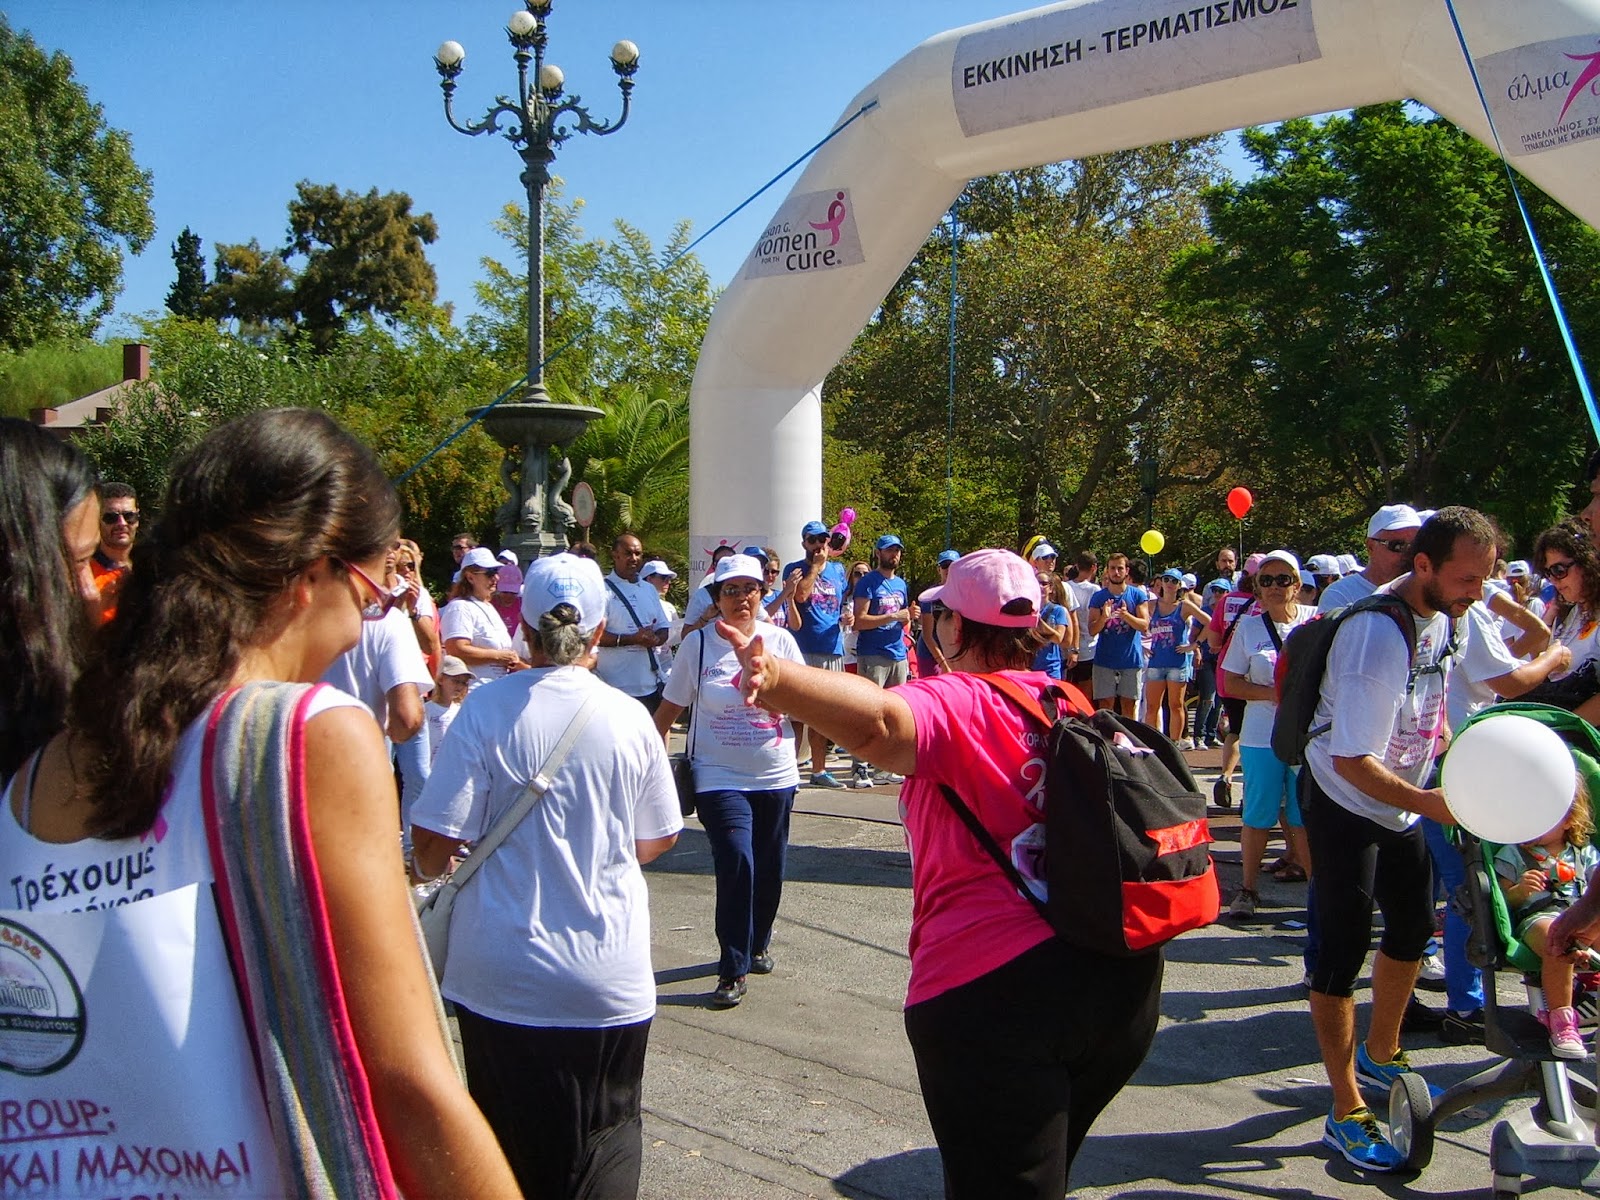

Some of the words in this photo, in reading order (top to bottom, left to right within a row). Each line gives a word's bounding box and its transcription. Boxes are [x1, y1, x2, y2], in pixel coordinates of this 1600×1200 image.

[963, 39, 1082, 89] ΕΚΚΙΝΗΣΗ
[1507, 71, 1570, 101] άλμα
[1521, 120, 1582, 144] ΠΑΝΕΛΛΗΝΙΟΣ
[1, 1098, 116, 1135] ROUP:
[75, 1141, 250, 1183] ΜΑΧΟΜΑΙ
